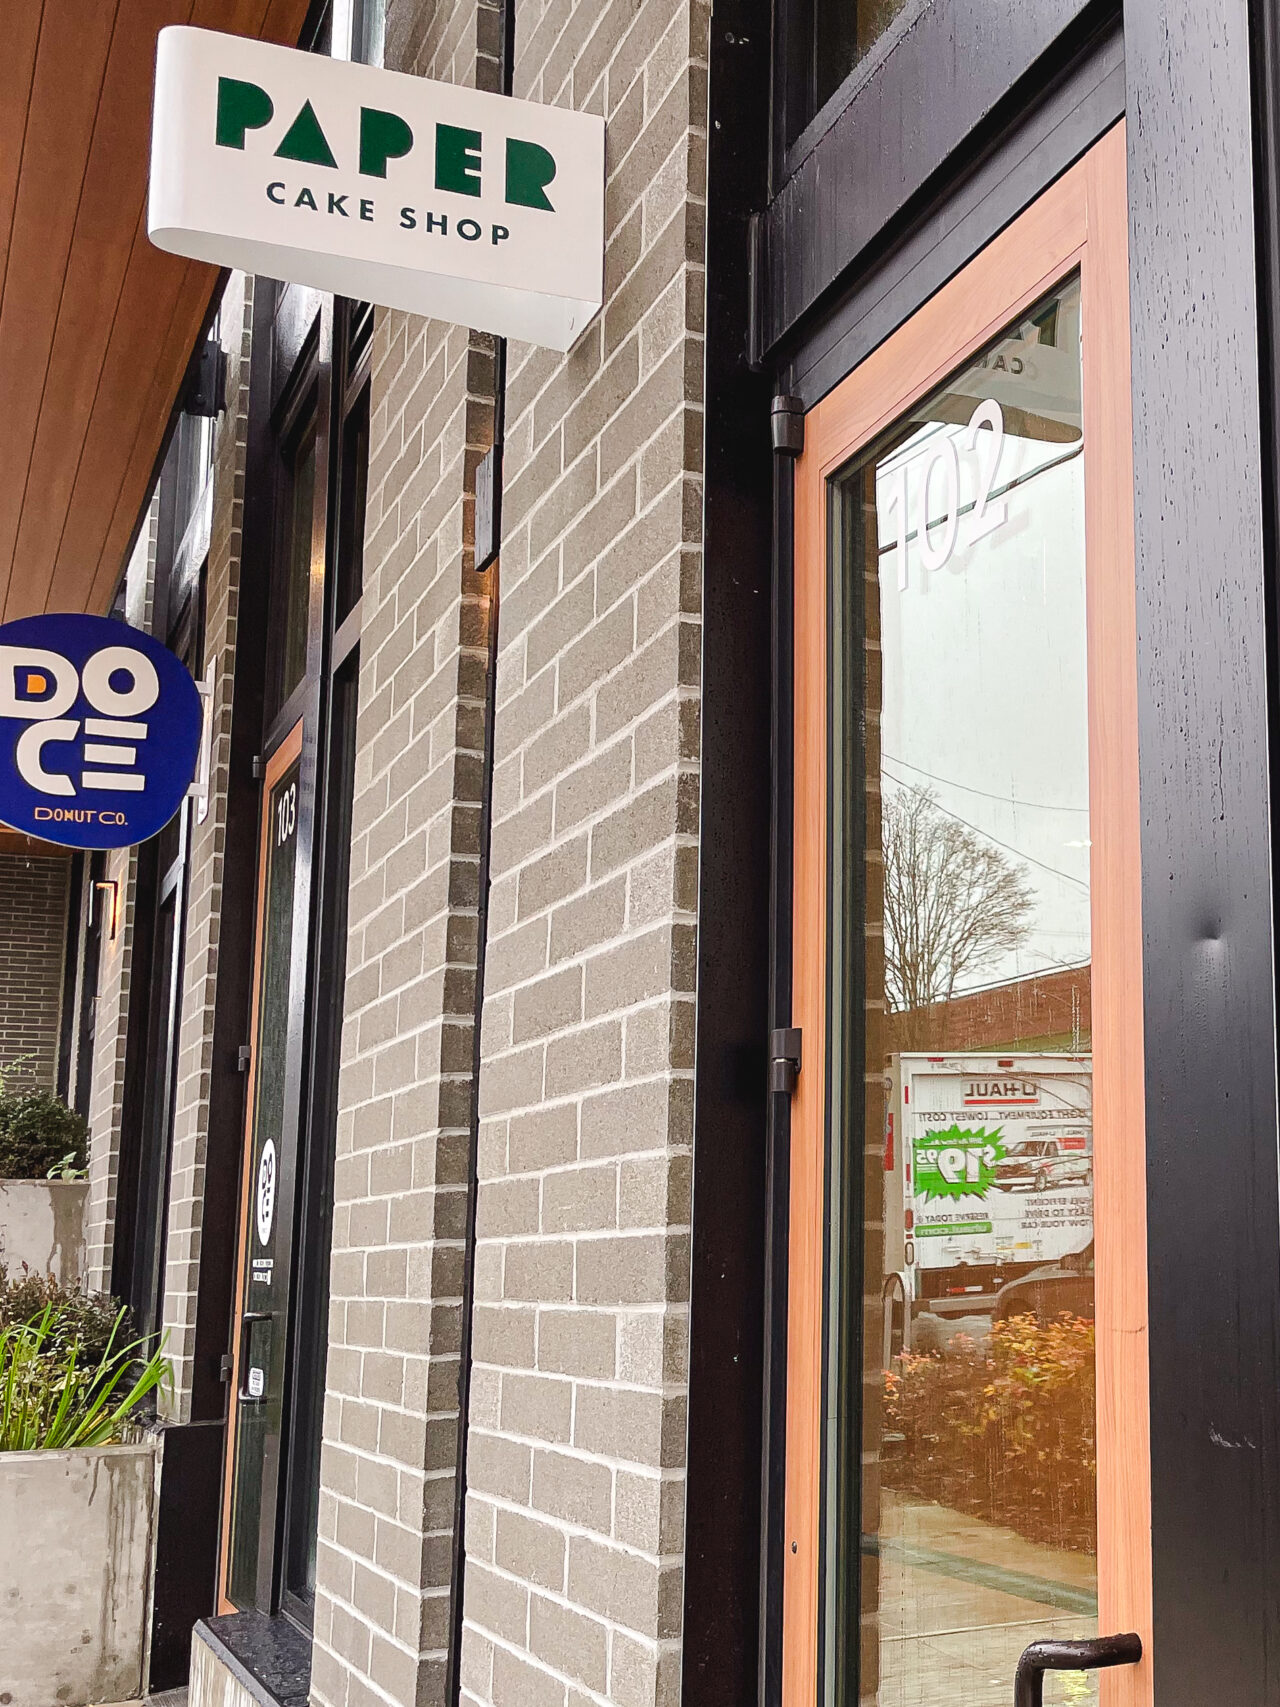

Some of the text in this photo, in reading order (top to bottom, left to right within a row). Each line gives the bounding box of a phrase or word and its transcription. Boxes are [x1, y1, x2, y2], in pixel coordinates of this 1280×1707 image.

[214, 75, 557, 214] PAPER
[265, 181, 510, 246] CAKE SHOP
[887, 398, 1009, 592] 102
[33, 806, 129, 827] DONUT CO.
[277, 782, 297, 847] 103
